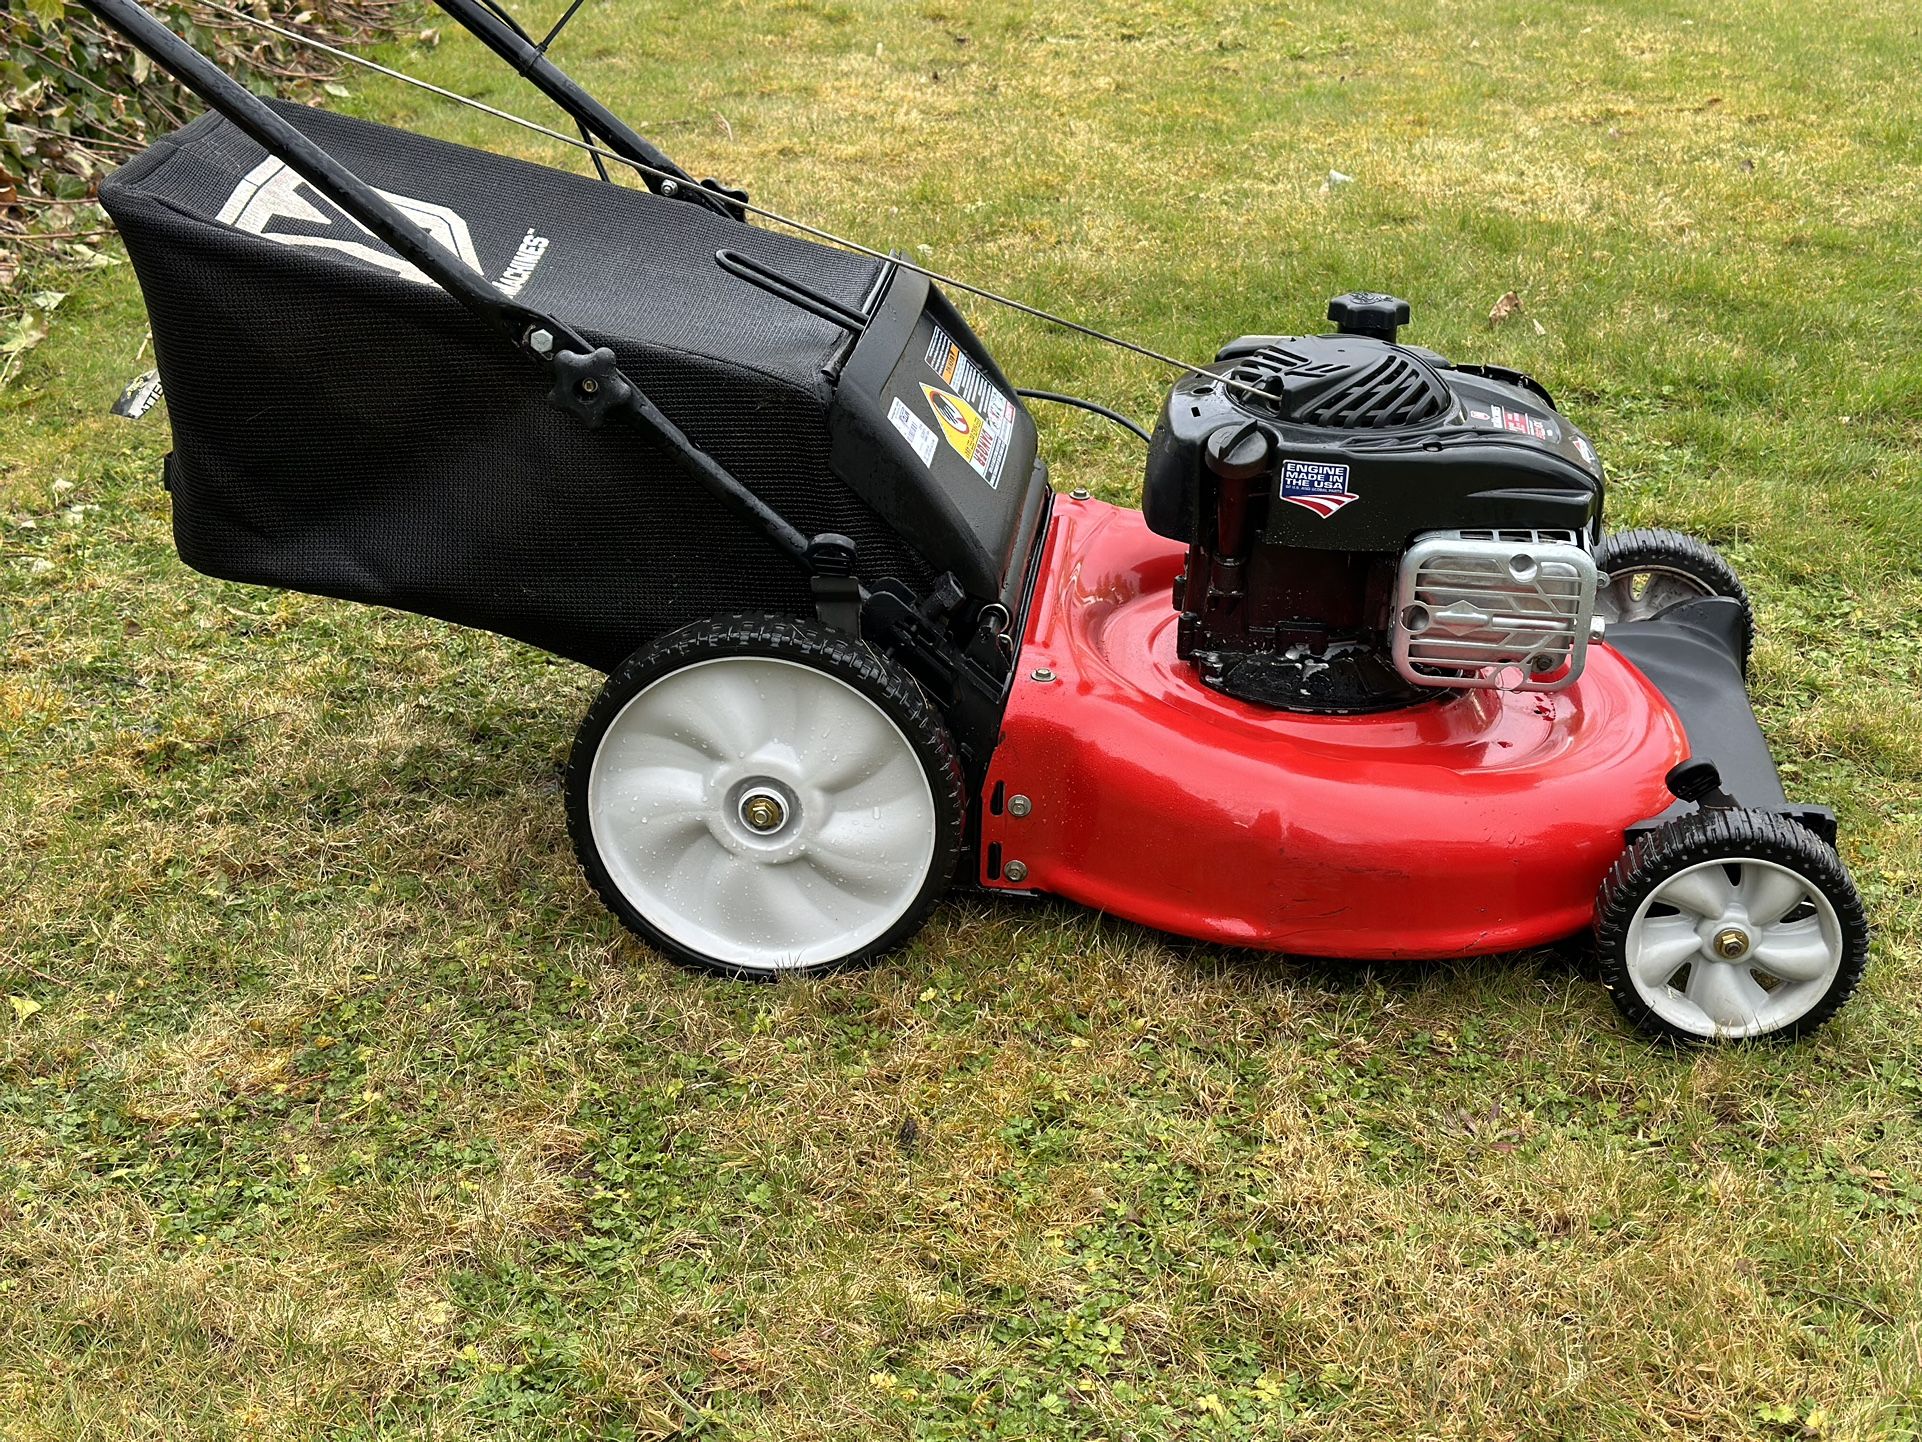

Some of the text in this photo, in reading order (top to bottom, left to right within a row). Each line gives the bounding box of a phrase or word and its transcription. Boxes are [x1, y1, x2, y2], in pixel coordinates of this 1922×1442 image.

[974, 428, 993, 467] DANGER
[1286, 463, 1344, 476] ENGINE
[1286, 471, 1344, 483] MADE IN
[1285, 478, 1343, 490] THE USA
